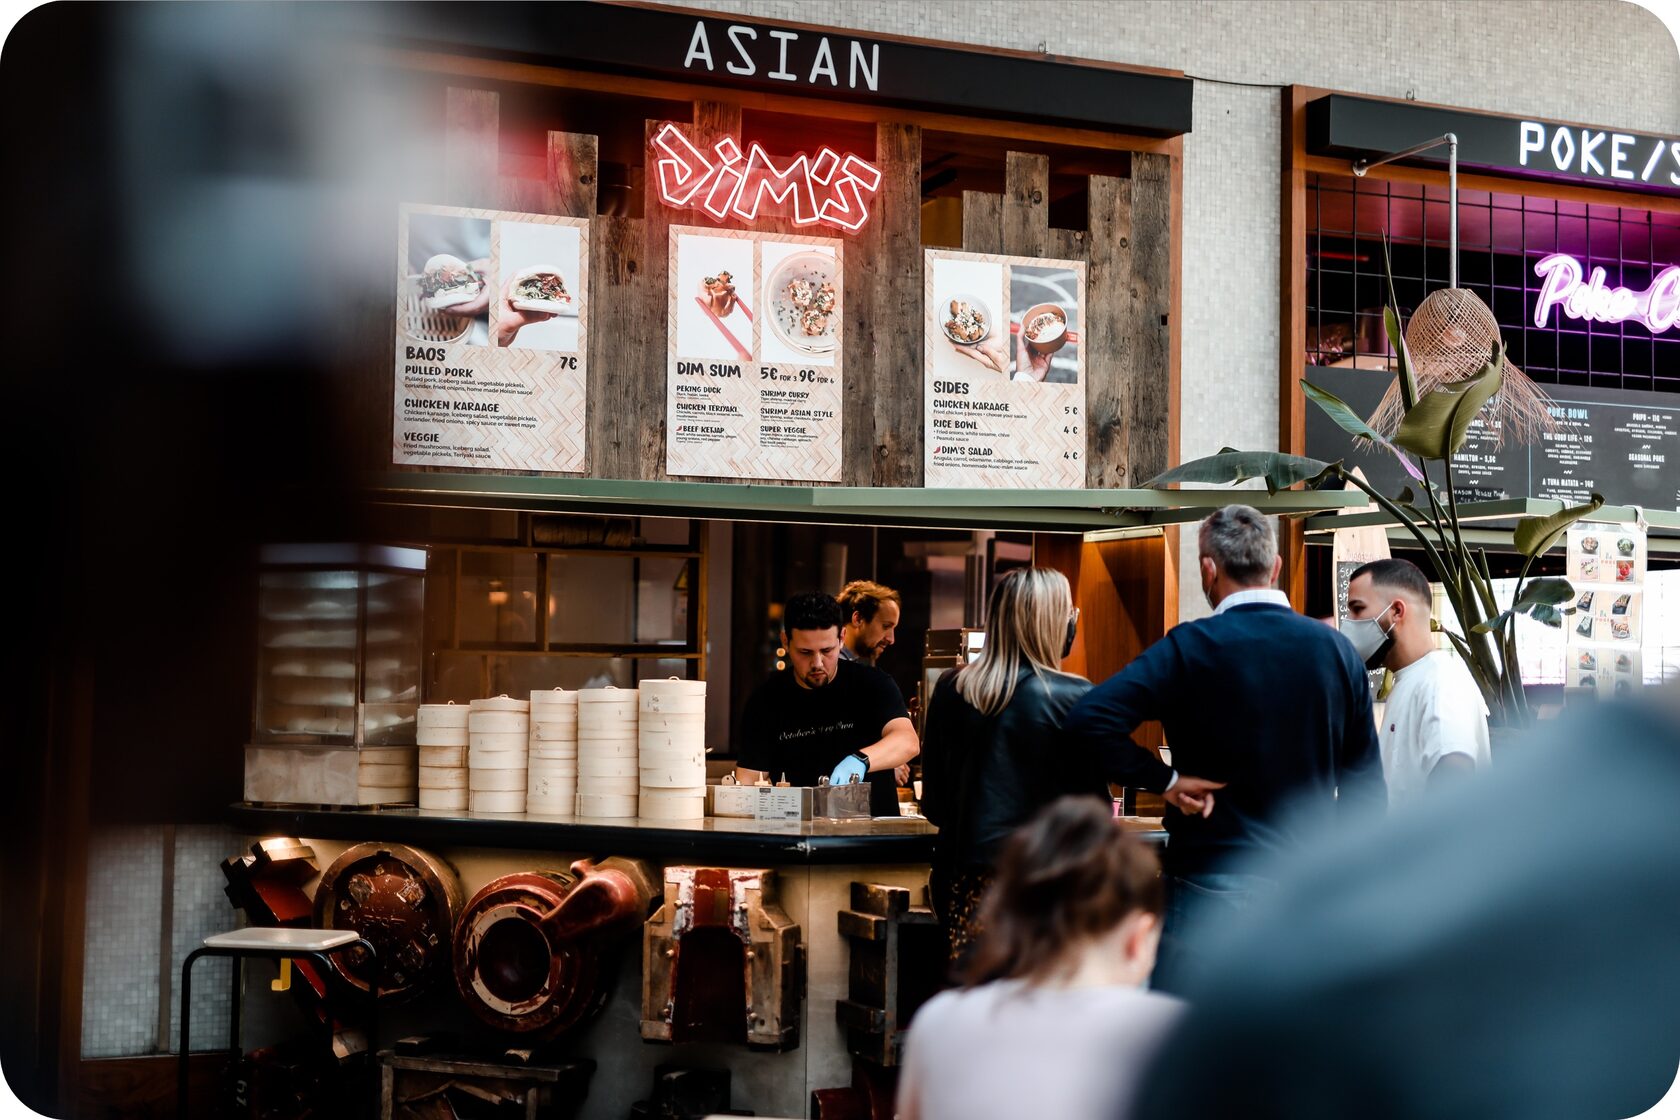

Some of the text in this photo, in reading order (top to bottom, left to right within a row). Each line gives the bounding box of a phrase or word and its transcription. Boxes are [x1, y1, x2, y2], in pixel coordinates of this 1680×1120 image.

[684, 21, 879, 91] ASIAN
[406, 346, 445, 361] BAOS
[560, 357, 578, 370] 7€
[405, 365, 473, 378] PULLED PORK
[677, 362, 741, 378] DIM SUM
[761, 367, 778, 380] 5€
[799, 370, 815, 382] 9€
[704, 386, 721, 394] DUCK
[934, 381, 969, 394] SIDES
[788, 391, 809, 399] CURRY
[405, 398, 499, 412] CHICKEN KARAAGE
[676, 403, 737, 412] CHICKEN TERIYAKI
[933, 399, 1010, 411] CHICKEN KARAAGE
[1568, 408, 1588, 419] BOWL
[760, 425, 806, 434] SUPER VEGGIE
[933, 419, 978, 429] RICE BOWL
[1064, 426, 1069, 434] 4
[404, 432, 440, 442] VEGGIE
[942, 446, 992, 456] DIM'S SALAD
[1064, 452, 1069, 460] 4
